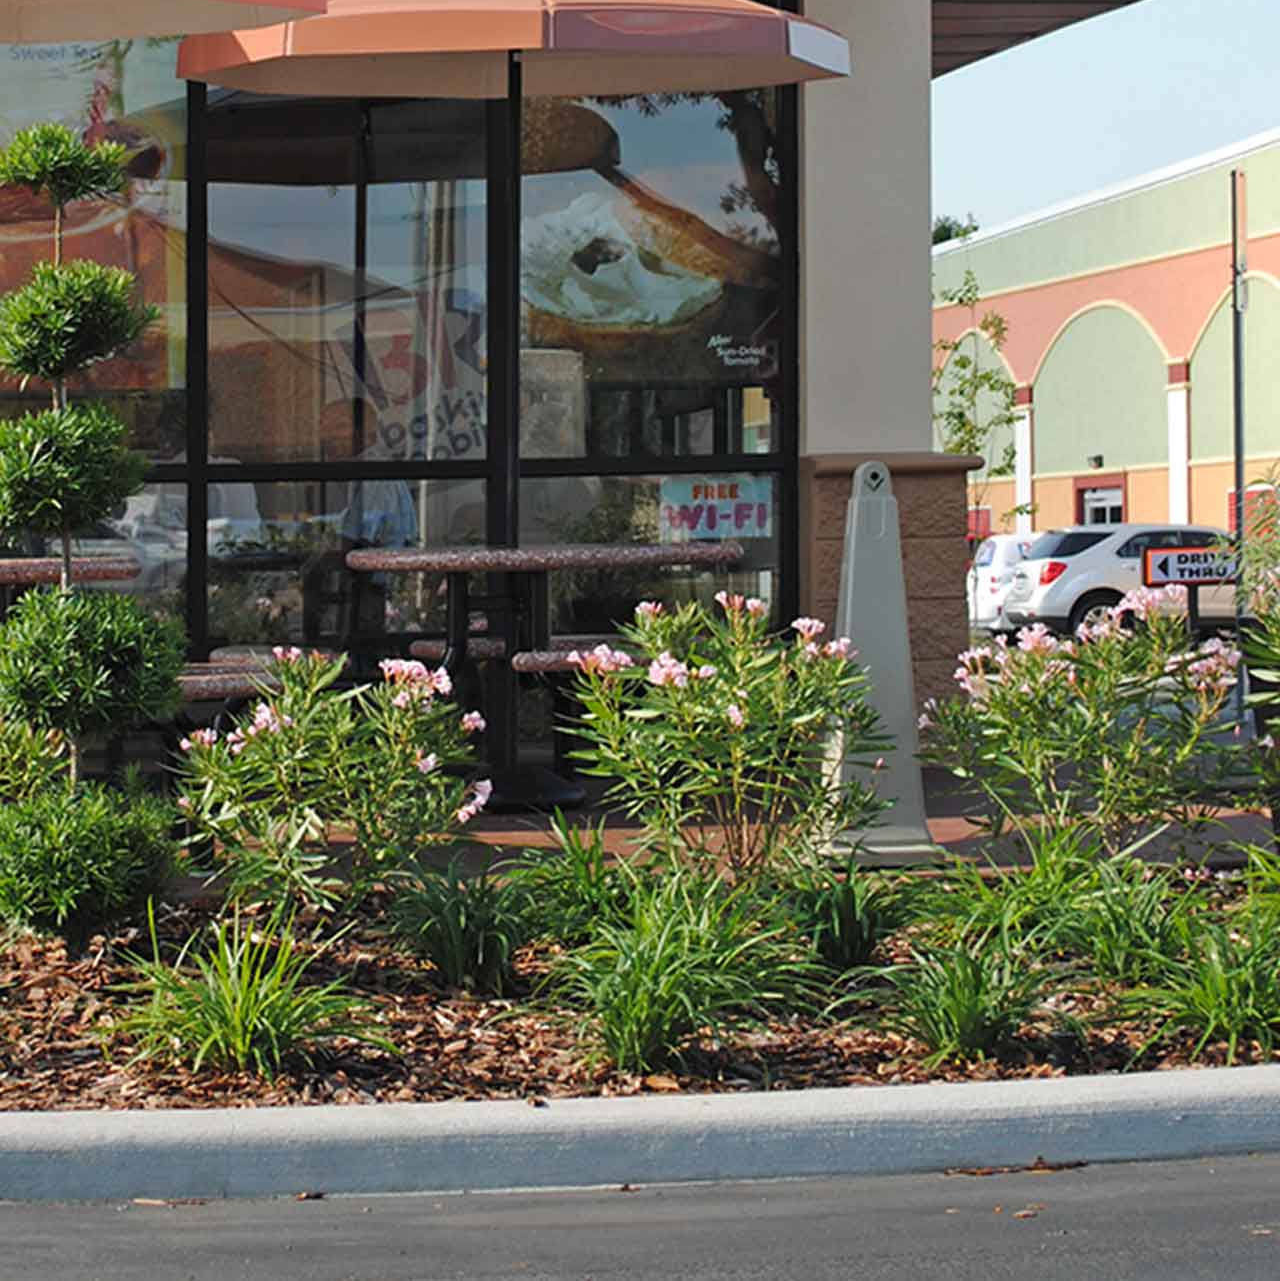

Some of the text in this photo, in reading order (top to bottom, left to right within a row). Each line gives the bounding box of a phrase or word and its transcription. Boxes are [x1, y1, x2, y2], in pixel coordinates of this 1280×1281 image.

[692, 483, 739, 500] FREE
[663, 503, 767, 531] WI-FI
[1177, 566, 1228, 579] THRU
